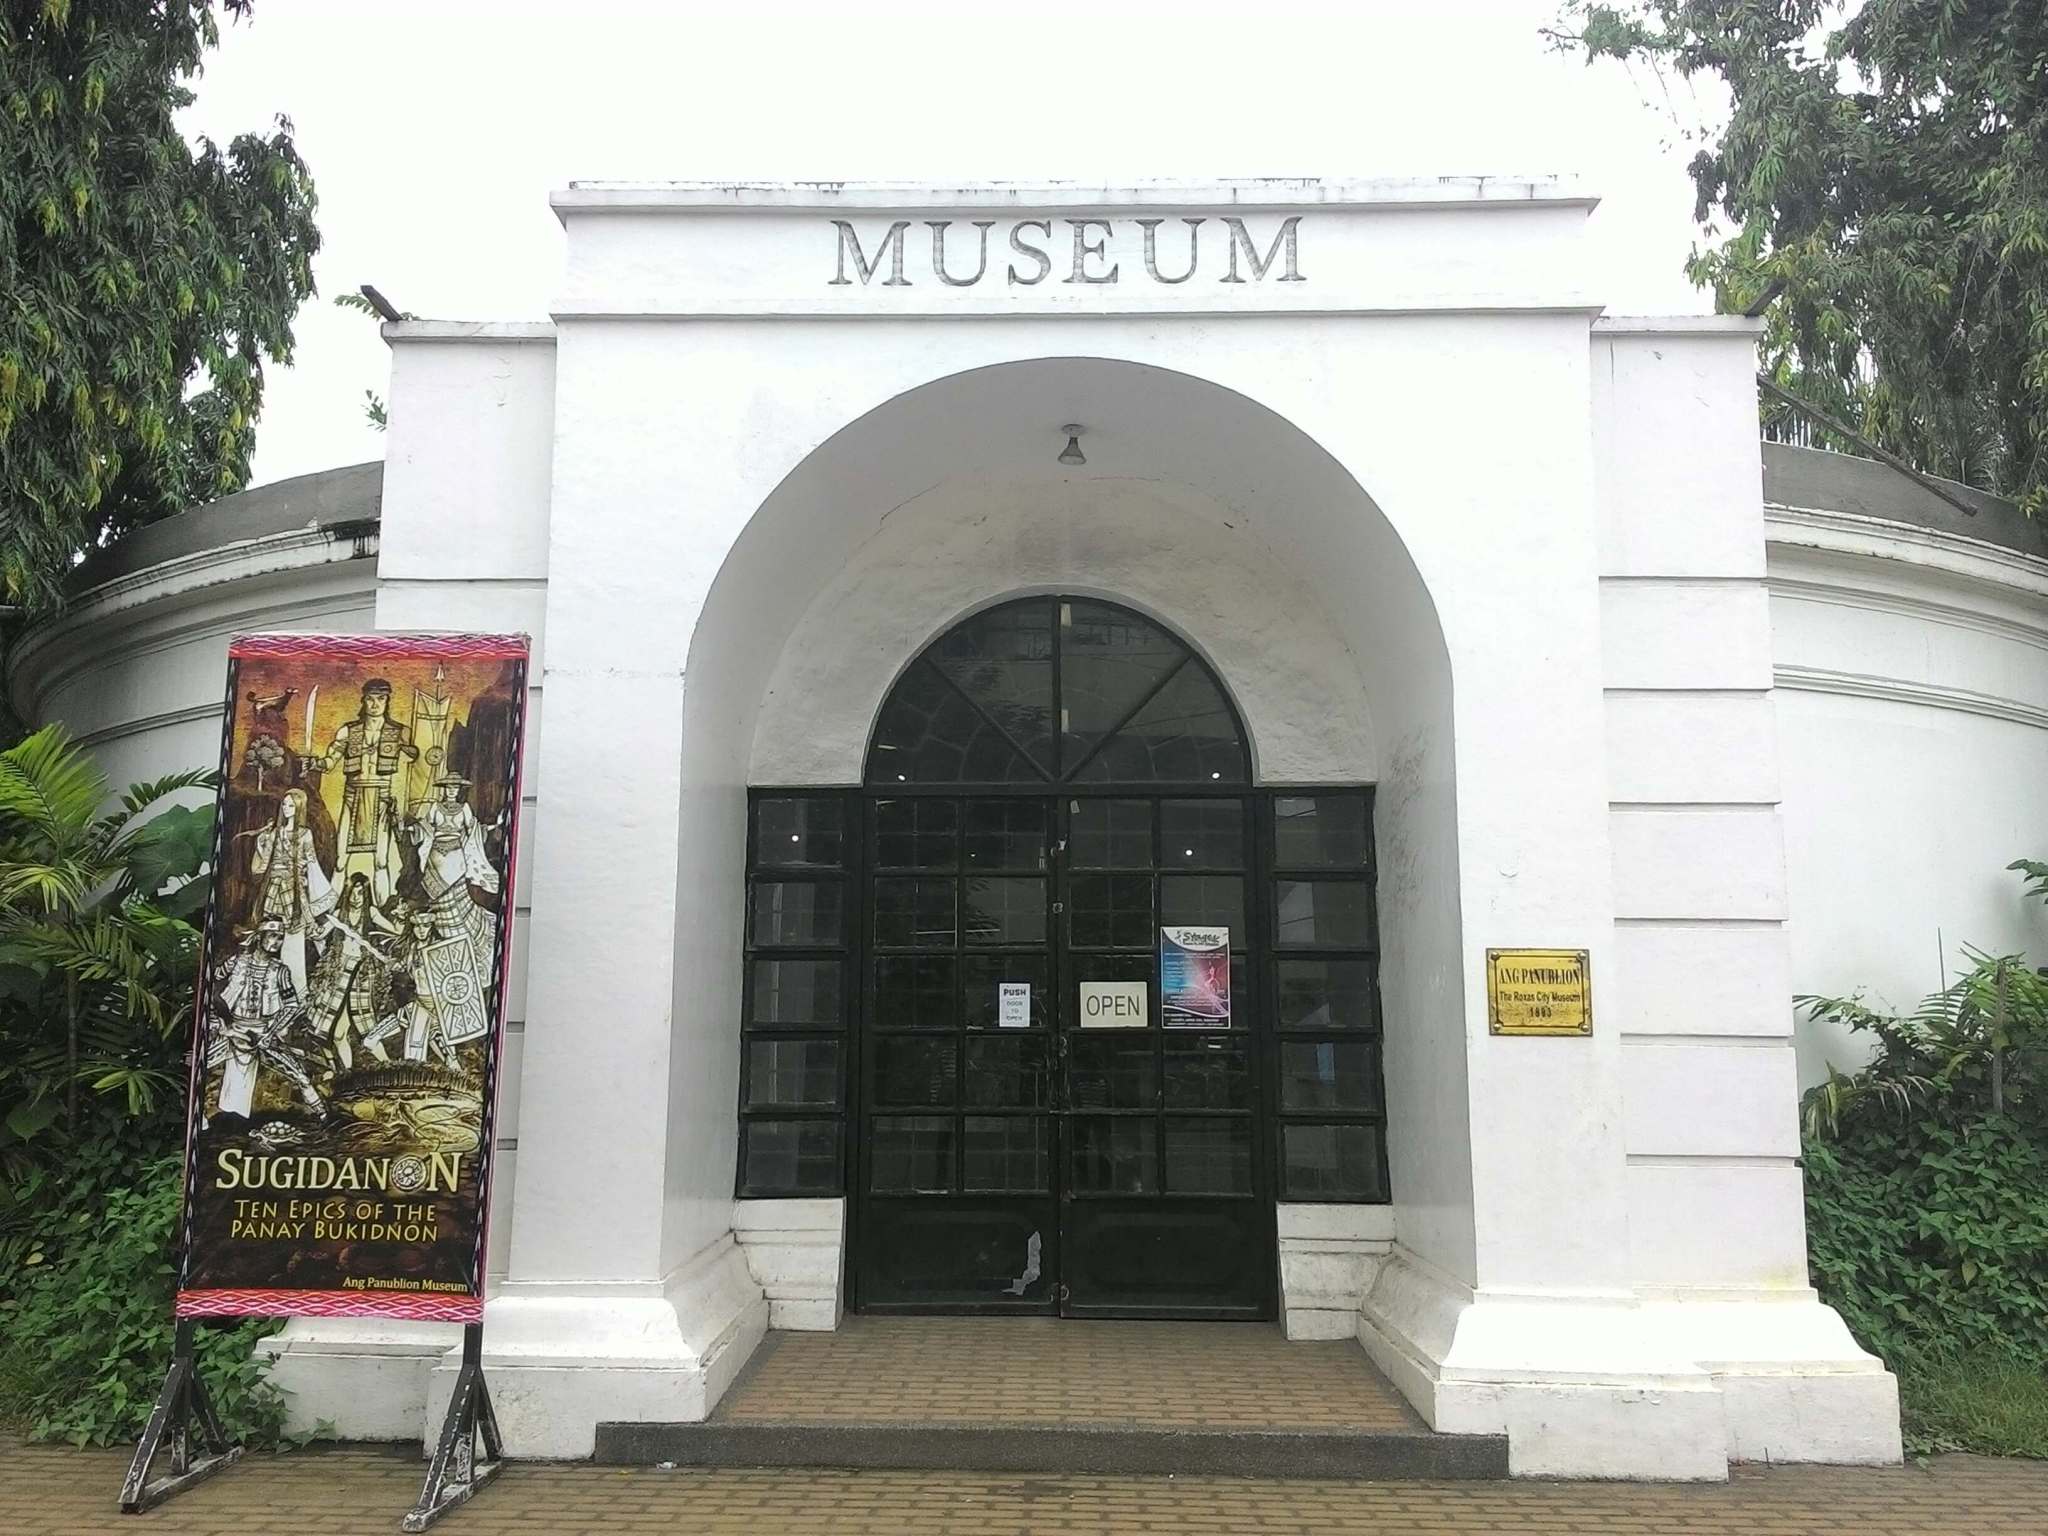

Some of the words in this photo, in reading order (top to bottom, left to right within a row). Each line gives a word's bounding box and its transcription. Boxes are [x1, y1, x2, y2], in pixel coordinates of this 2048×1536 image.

[827, 216, 1307, 287] MUSEUM
[1499, 968, 1520, 984] ANG
[1521, 968, 1580, 985] PANUBLION
[1003, 988, 1026, 996] PUSH
[1500, 991, 1512, 1001] The
[1513, 991, 1535, 1001] Roxas
[1536, 991, 1550, 1004] City
[1551, 992, 1580, 1002] Museum
[1086, 995, 1140, 1016] OPEN
[215, 1148, 463, 1193] SUGIDANON
[234, 1199, 277, 1219] TEN
[289, 1199, 346, 1220] EPICS
[355, 1203, 384, 1220] OF
[393, 1204, 436, 1222] THE
[230, 1219, 310, 1240] PANAY
[314, 1220, 438, 1242] BUKIDNON
[342, 1276, 365, 1290] Ang
[367, 1277, 420, 1289] Panublion
[422, 1279, 468, 1292] Museum
